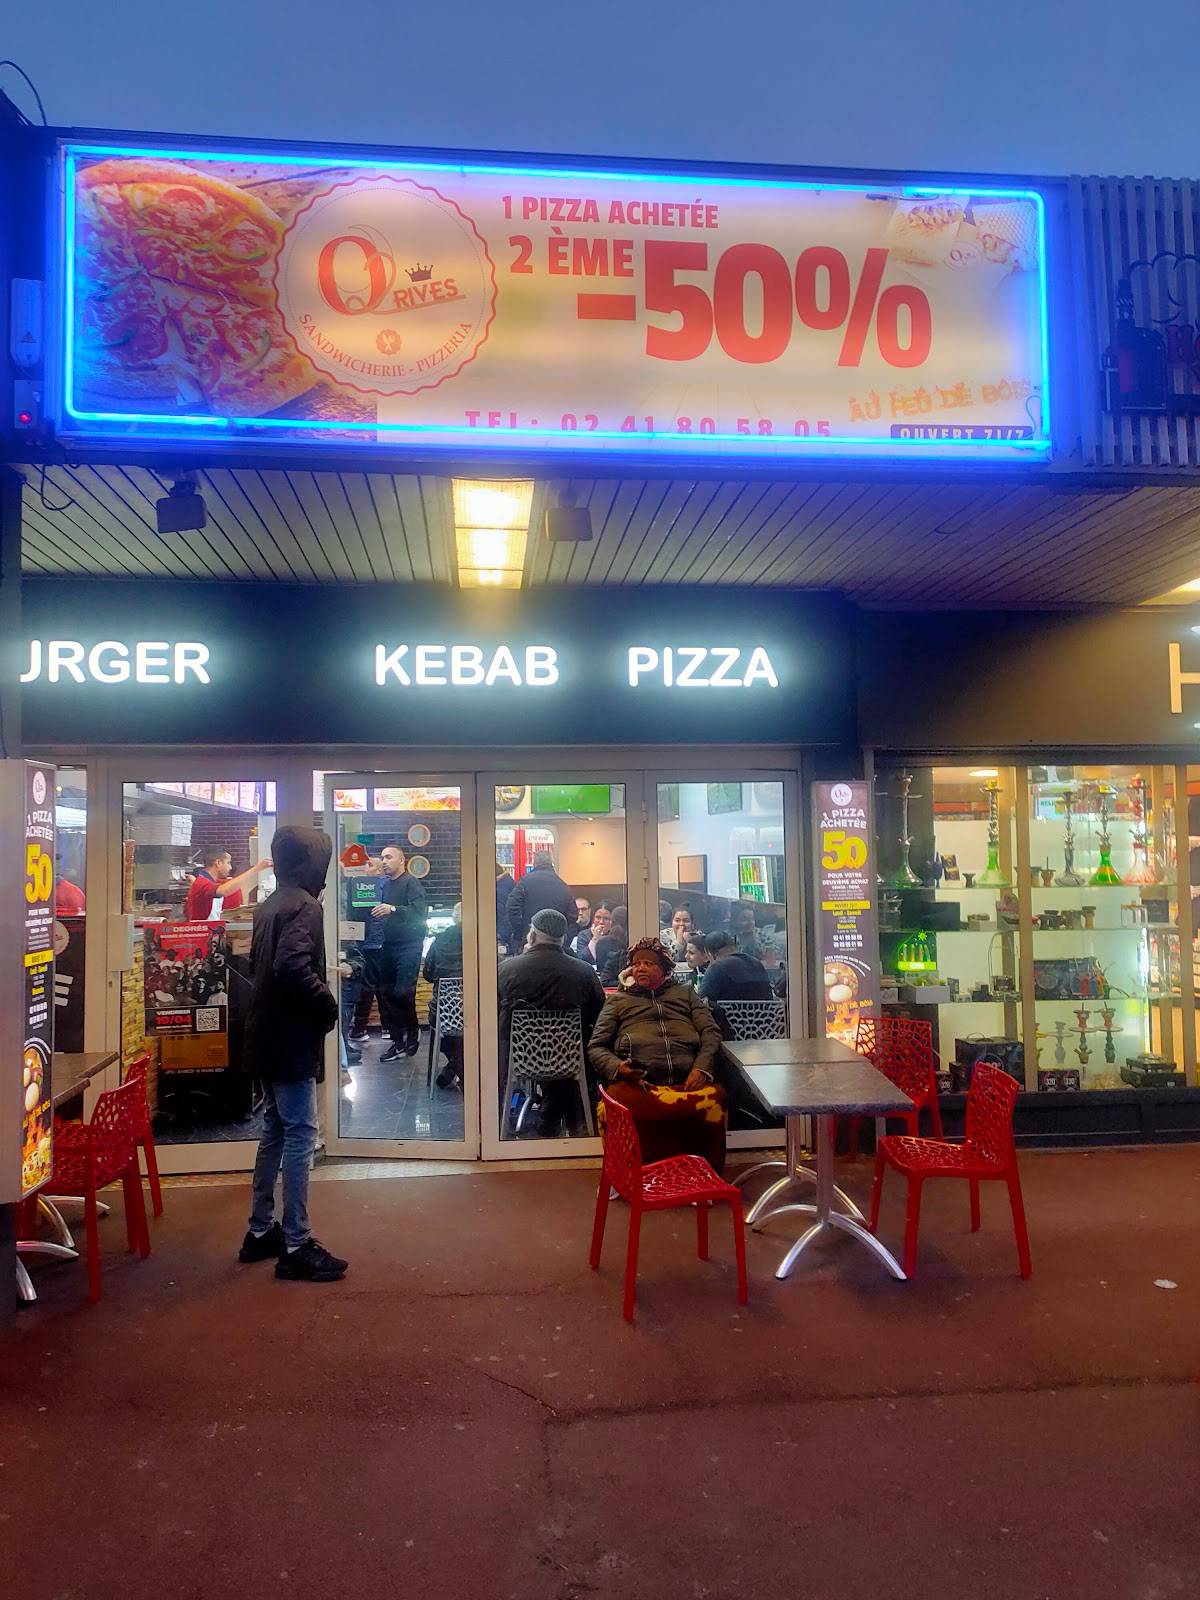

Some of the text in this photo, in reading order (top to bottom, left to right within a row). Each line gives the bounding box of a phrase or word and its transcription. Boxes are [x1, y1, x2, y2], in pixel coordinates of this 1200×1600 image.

[502, 196, 719, 229] 1 PIZZA ACHETÉE
[509, 227, 635, 277] 2 ÈME
[393, 278, 461, 310] RIVES
[576, 239, 933, 369] -50%
[299, 314, 407, 376] SANDWICHERIE
[416, 321, 473, 373] PIZZERIA
[561, 414, 599, 431] 02
[620, 416, 655, 433] 41
[677, 417, 716, 434] 80
[736, 418, 773, 436] 58
[794, 420, 831, 437] 05
[375, 644, 560, 687] KEBAB
[628, 646, 780, 688] PIZZA
[32, 810, 53, 825] PIZZA
[832, 808, 866, 819] PIZZA
[821, 830, 868, 870] 50
[25, 843, 53, 903] 50
[356, 883, 375, 891] Uber
[356, 891, 376, 899] Eats
